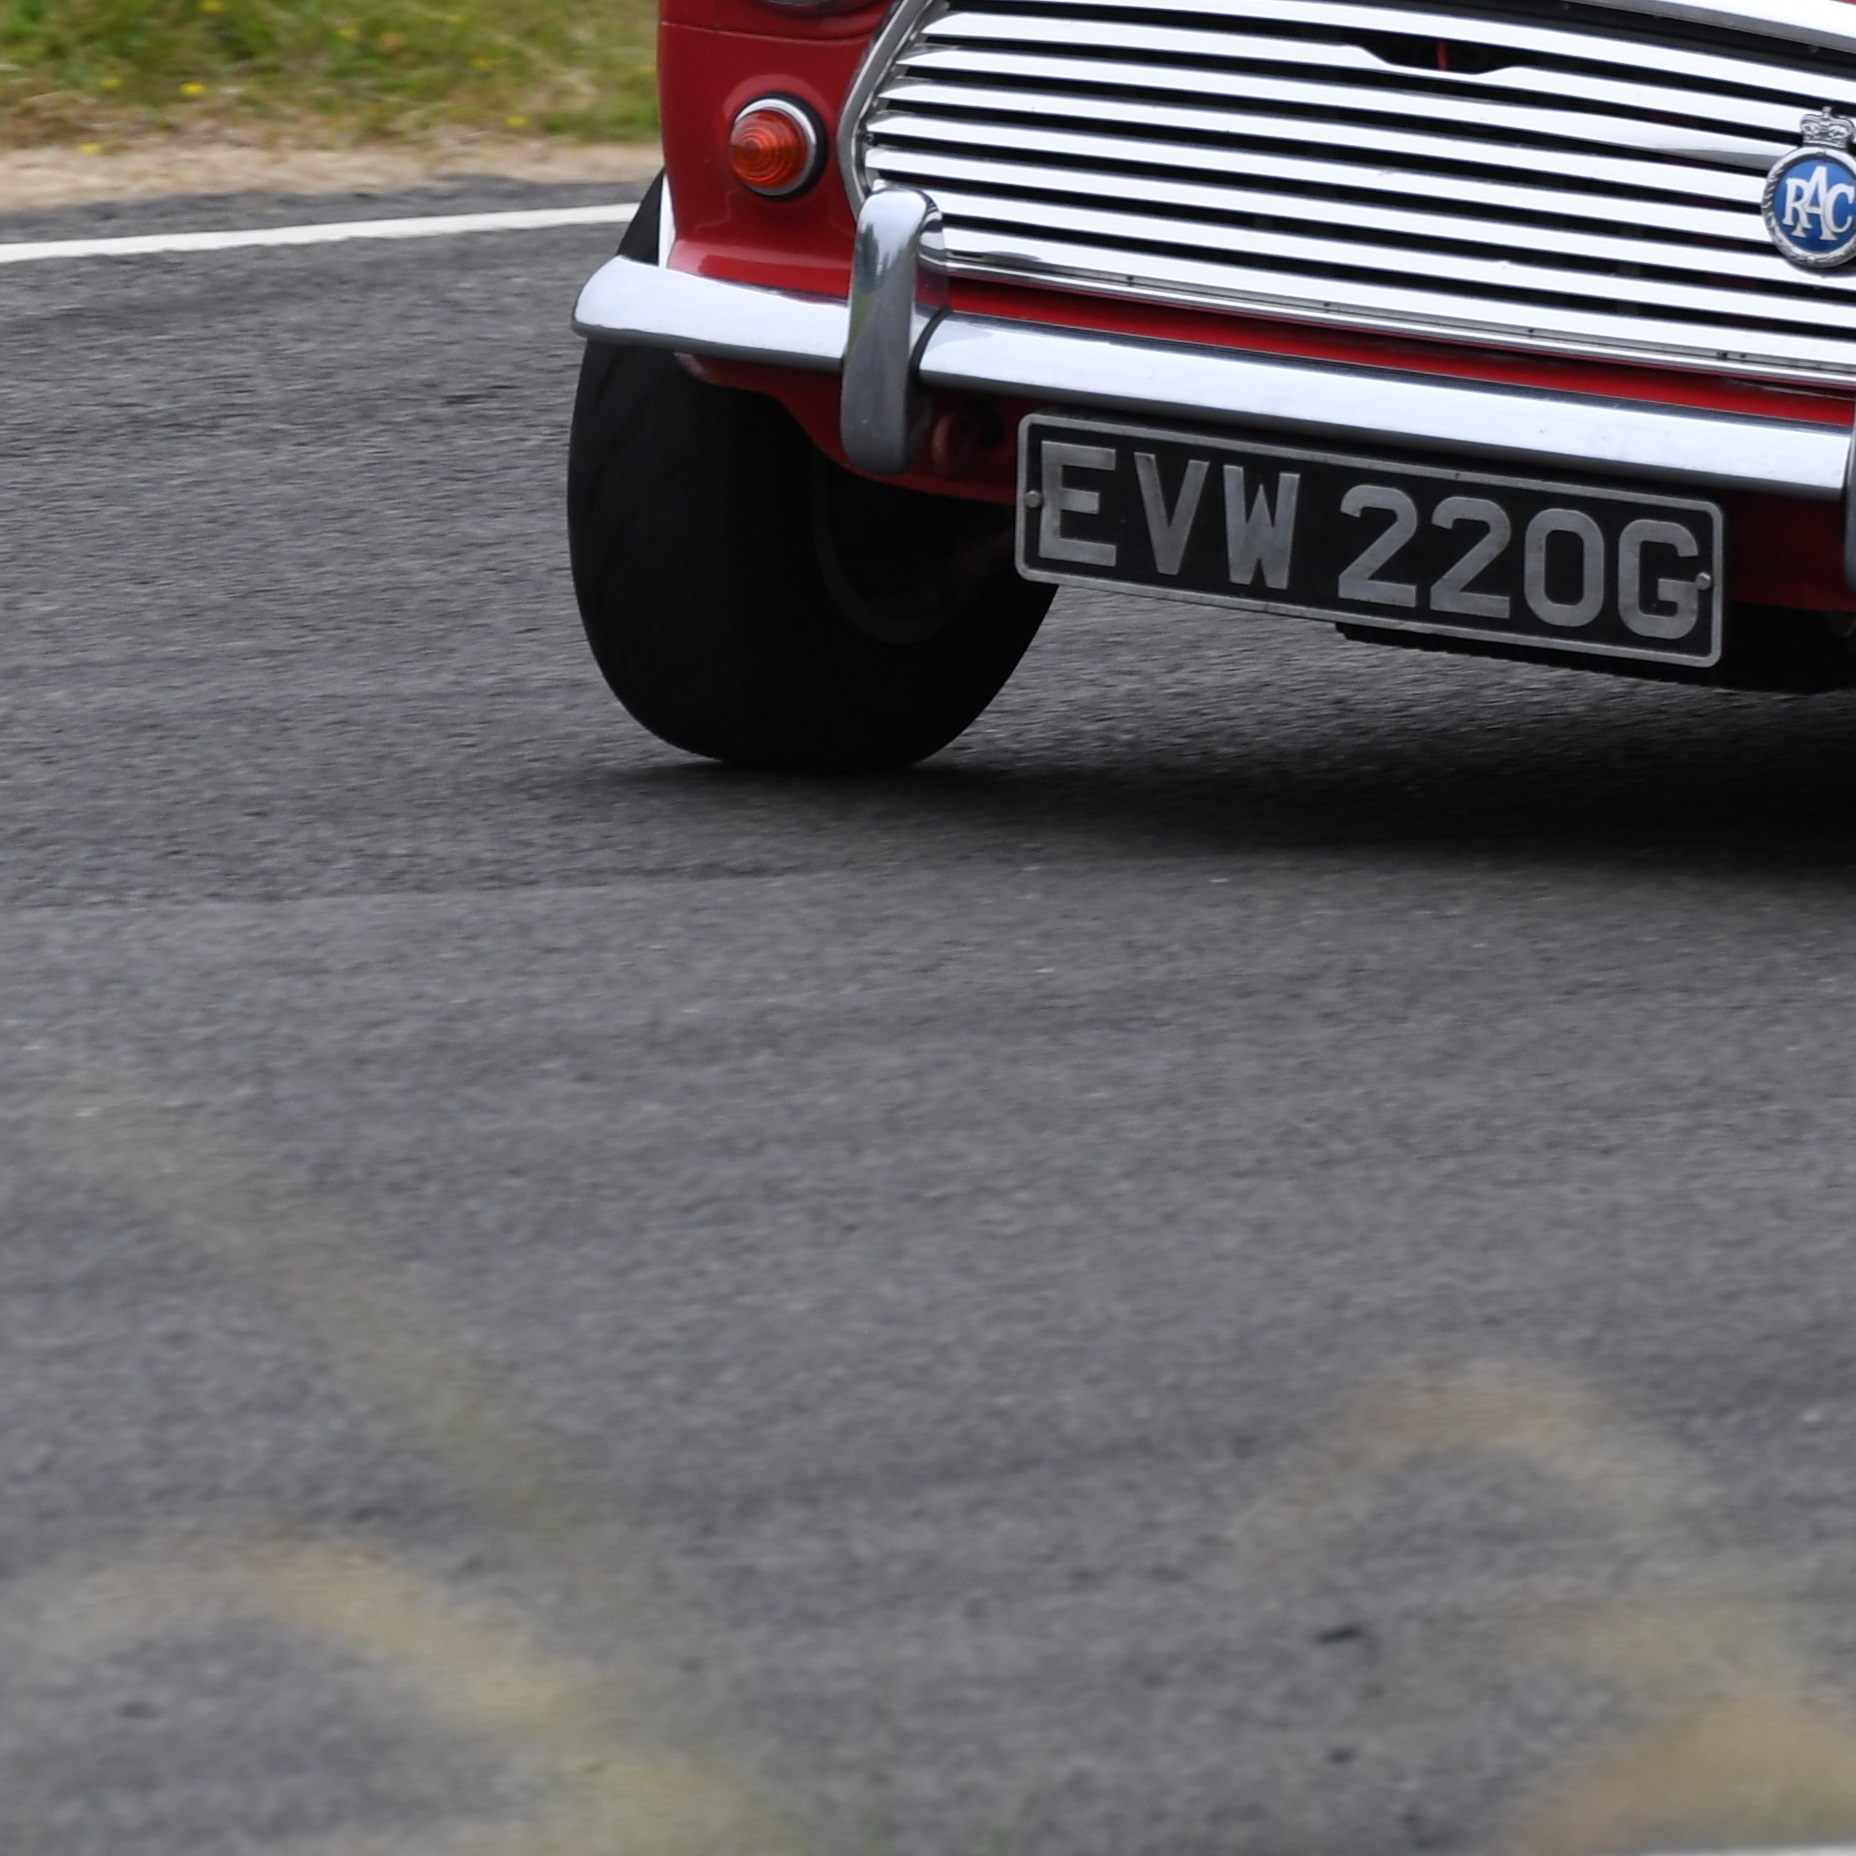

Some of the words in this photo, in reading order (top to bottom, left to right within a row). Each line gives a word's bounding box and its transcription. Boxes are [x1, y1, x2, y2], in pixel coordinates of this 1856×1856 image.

[1781, 165, 1856, 241] RAC
[1037, 440, 1301, 591] EVW
[1337, 484, 1700, 640] 220G
